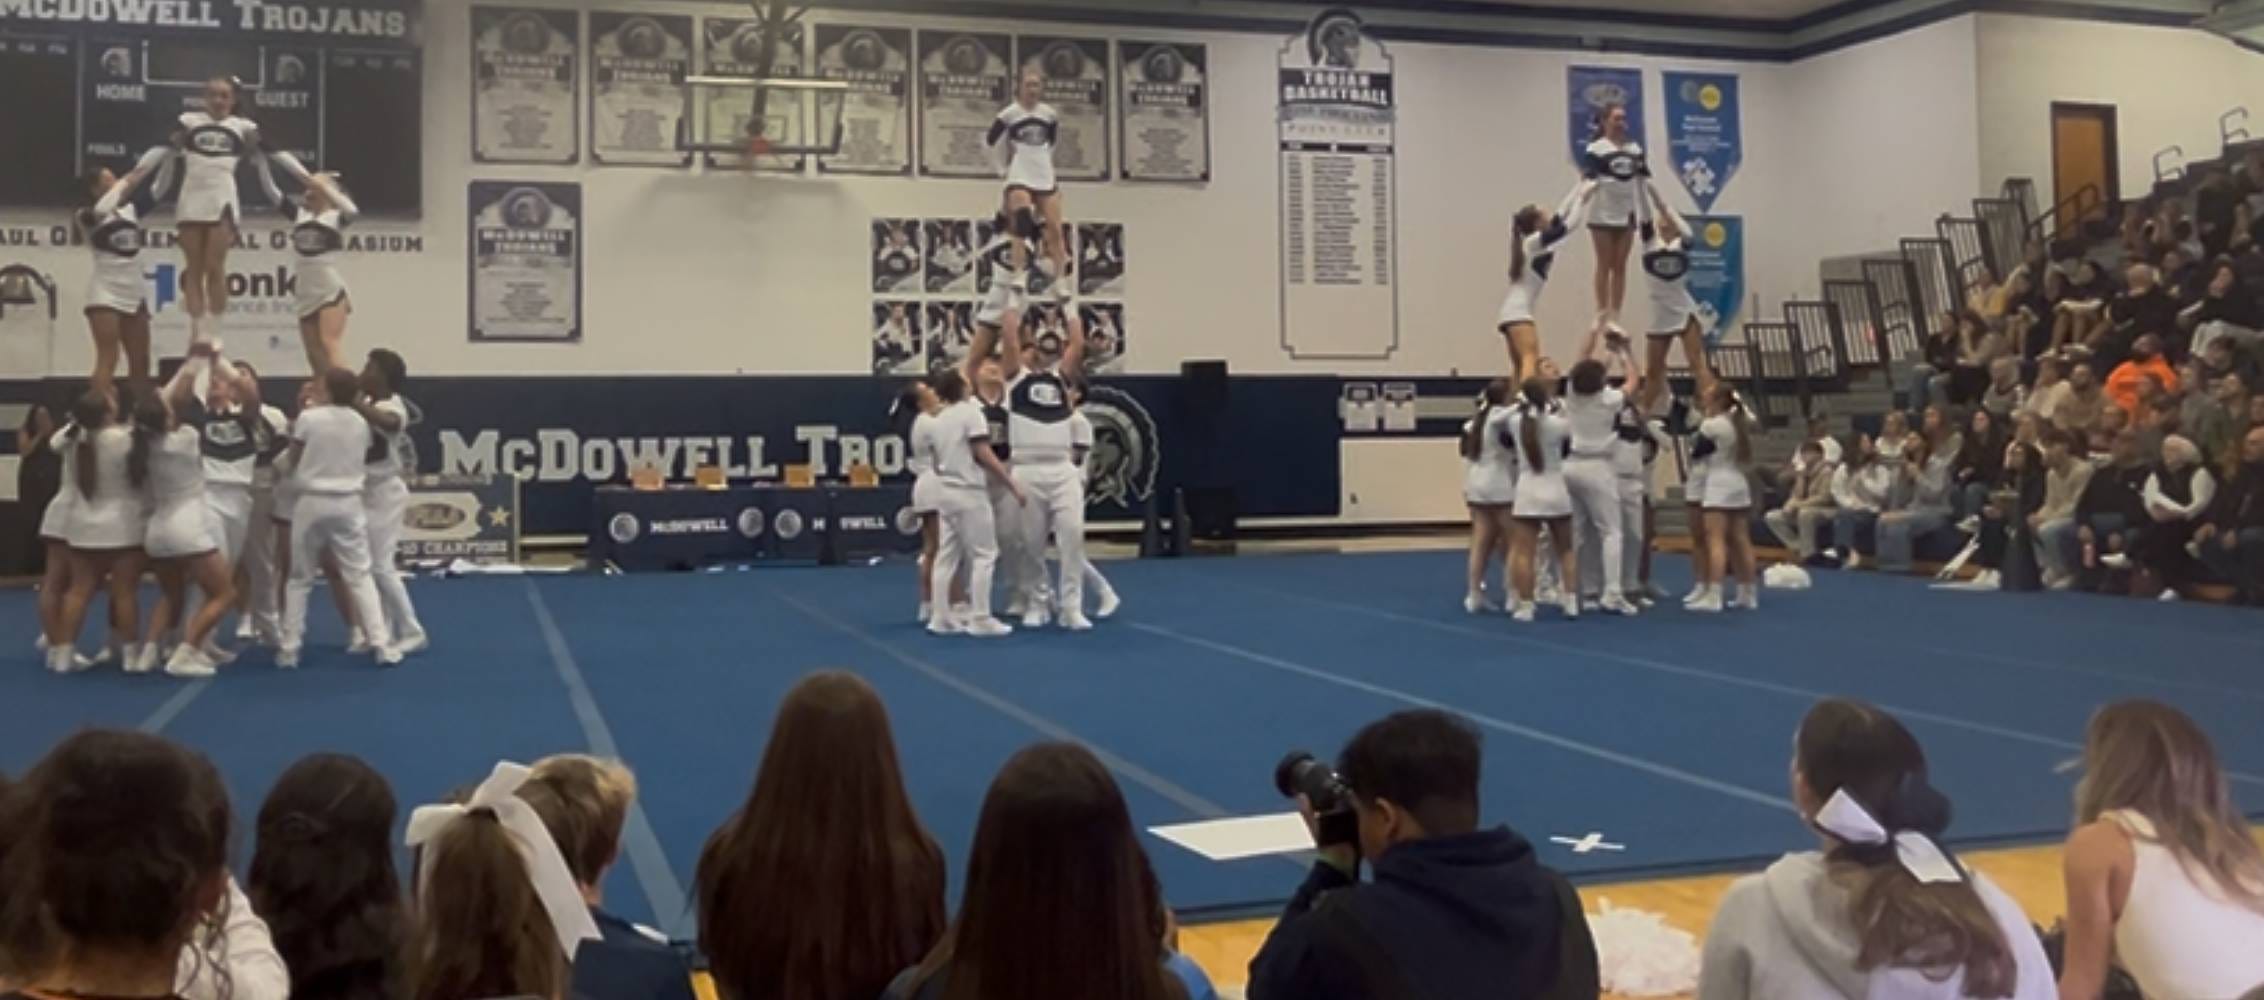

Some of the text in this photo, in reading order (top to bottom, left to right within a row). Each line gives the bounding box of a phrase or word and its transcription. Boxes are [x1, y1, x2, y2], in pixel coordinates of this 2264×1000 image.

[233, 0, 406, 37] TROJANS
[1303, 71, 1370, 86] TROJAN
[96, 84, 146, 101] HOME
[255, 90, 309, 109] GUEST
[1284, 85, 1388, 105] BASKETBALL
